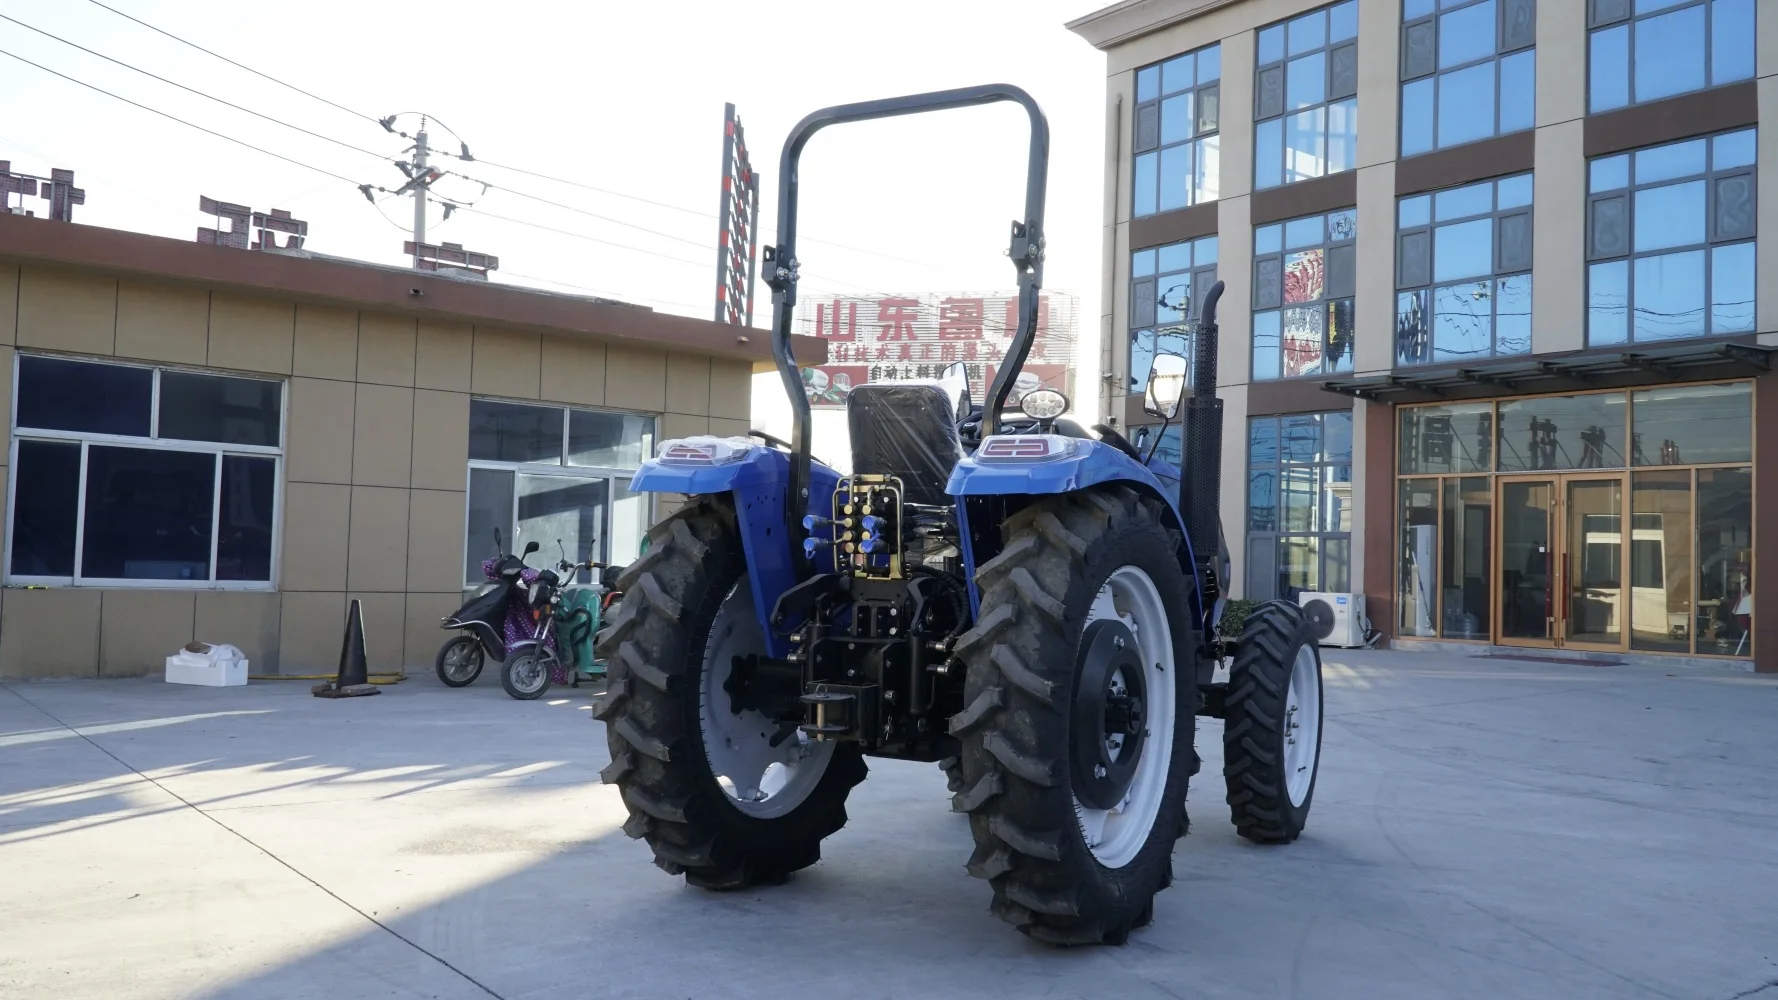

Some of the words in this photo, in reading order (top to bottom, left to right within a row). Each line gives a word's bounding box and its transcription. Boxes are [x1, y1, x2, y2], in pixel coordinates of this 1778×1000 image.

[871, 364, 982, 380] 自动上料搅机
